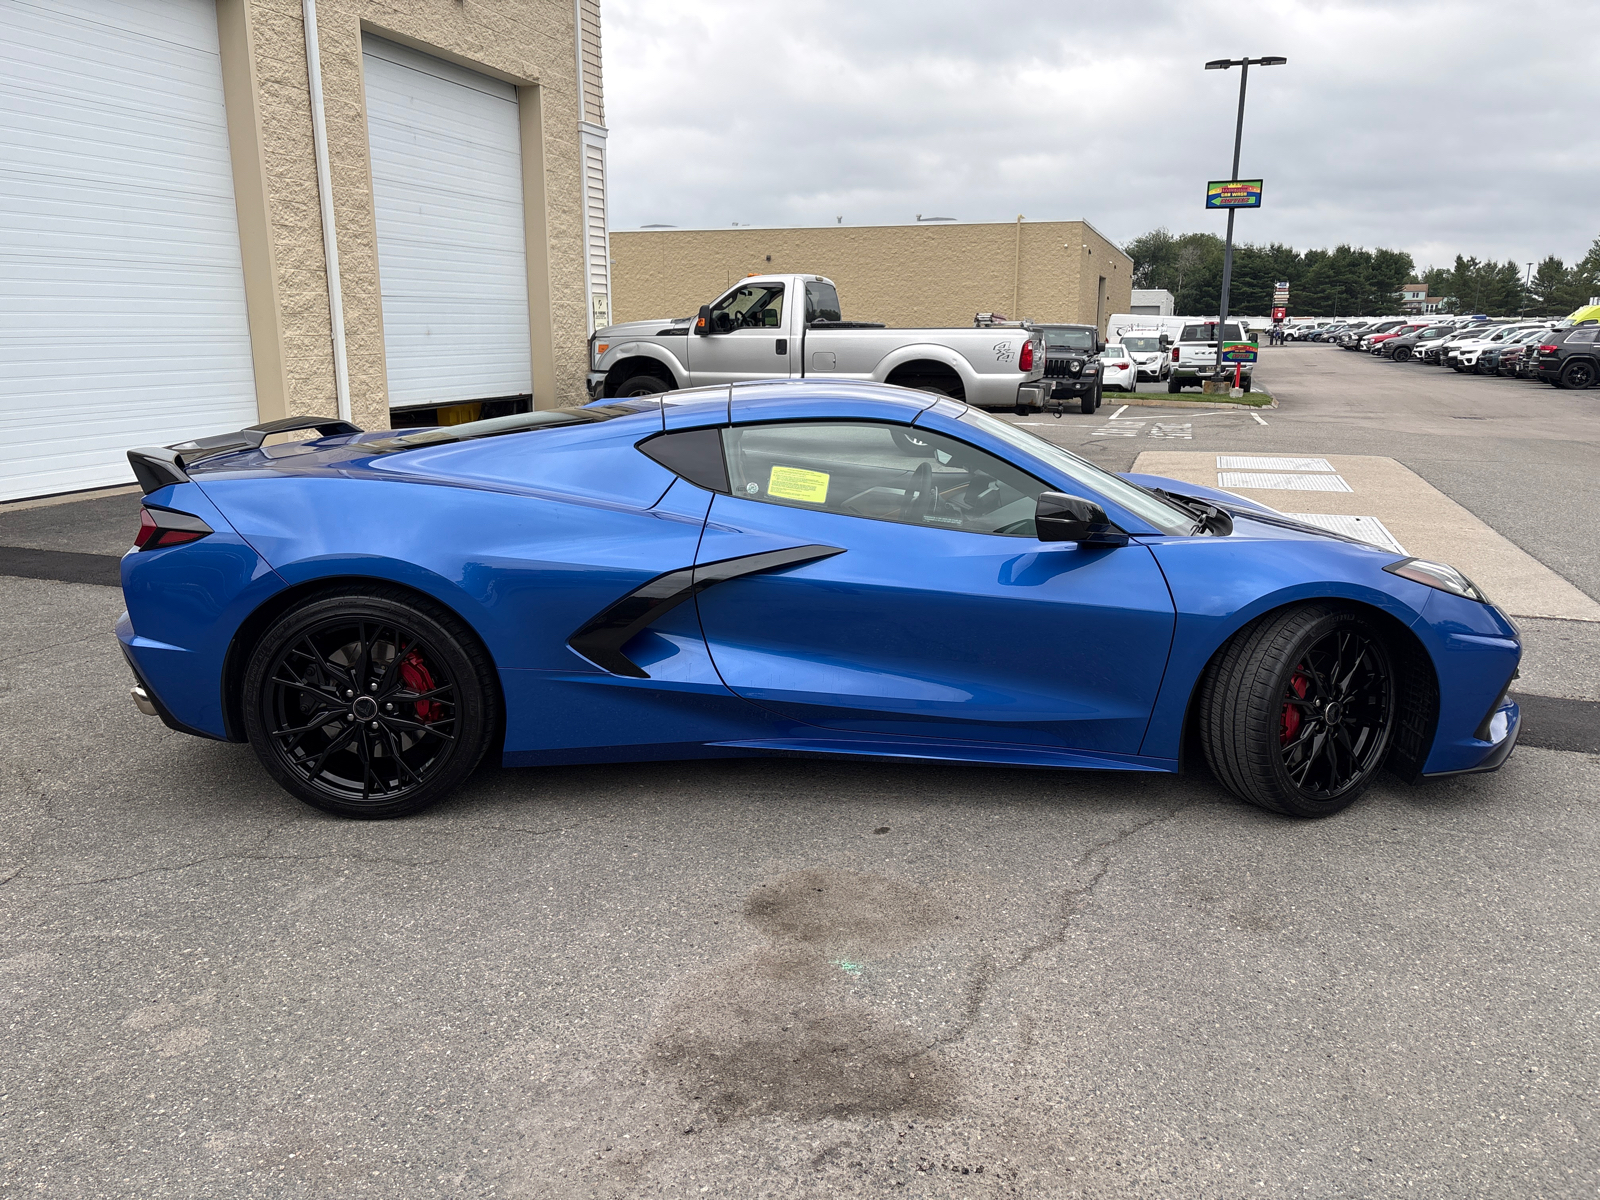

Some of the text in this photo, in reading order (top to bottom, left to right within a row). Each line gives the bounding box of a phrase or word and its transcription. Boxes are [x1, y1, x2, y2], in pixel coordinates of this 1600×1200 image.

[250, 662, 260, 680] SPORT
[258, 648, 266, 660] ALL
[265, 627, 285, 648] SEASON
